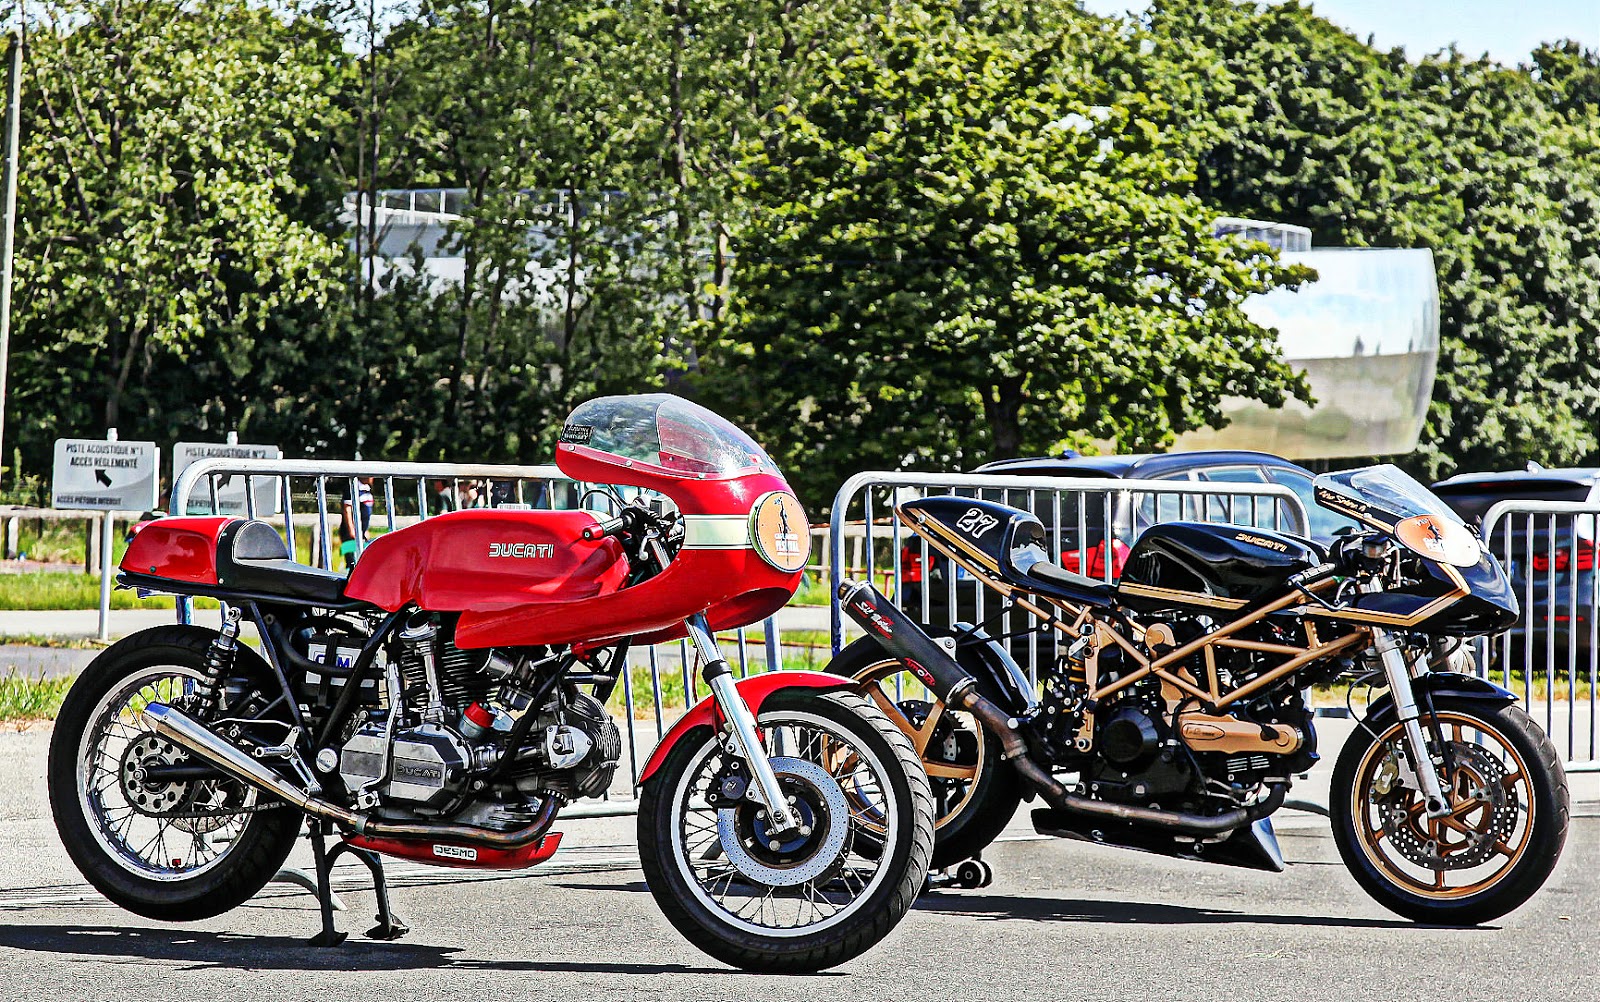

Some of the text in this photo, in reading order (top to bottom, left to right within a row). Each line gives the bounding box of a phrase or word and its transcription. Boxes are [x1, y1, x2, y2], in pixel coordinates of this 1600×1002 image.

[66, 443, 84, 453] PISTE
[87, 444, 128, 455] ACOUSTIQUE
[956, 507, 999, 539] 27
[488, 542, 555, 559] DUCATI
[1235, 532, 1288, 553] DUCATI
[397, 764, 442, 779] DUCATI
[434, 845, 475, 859] DESMO
